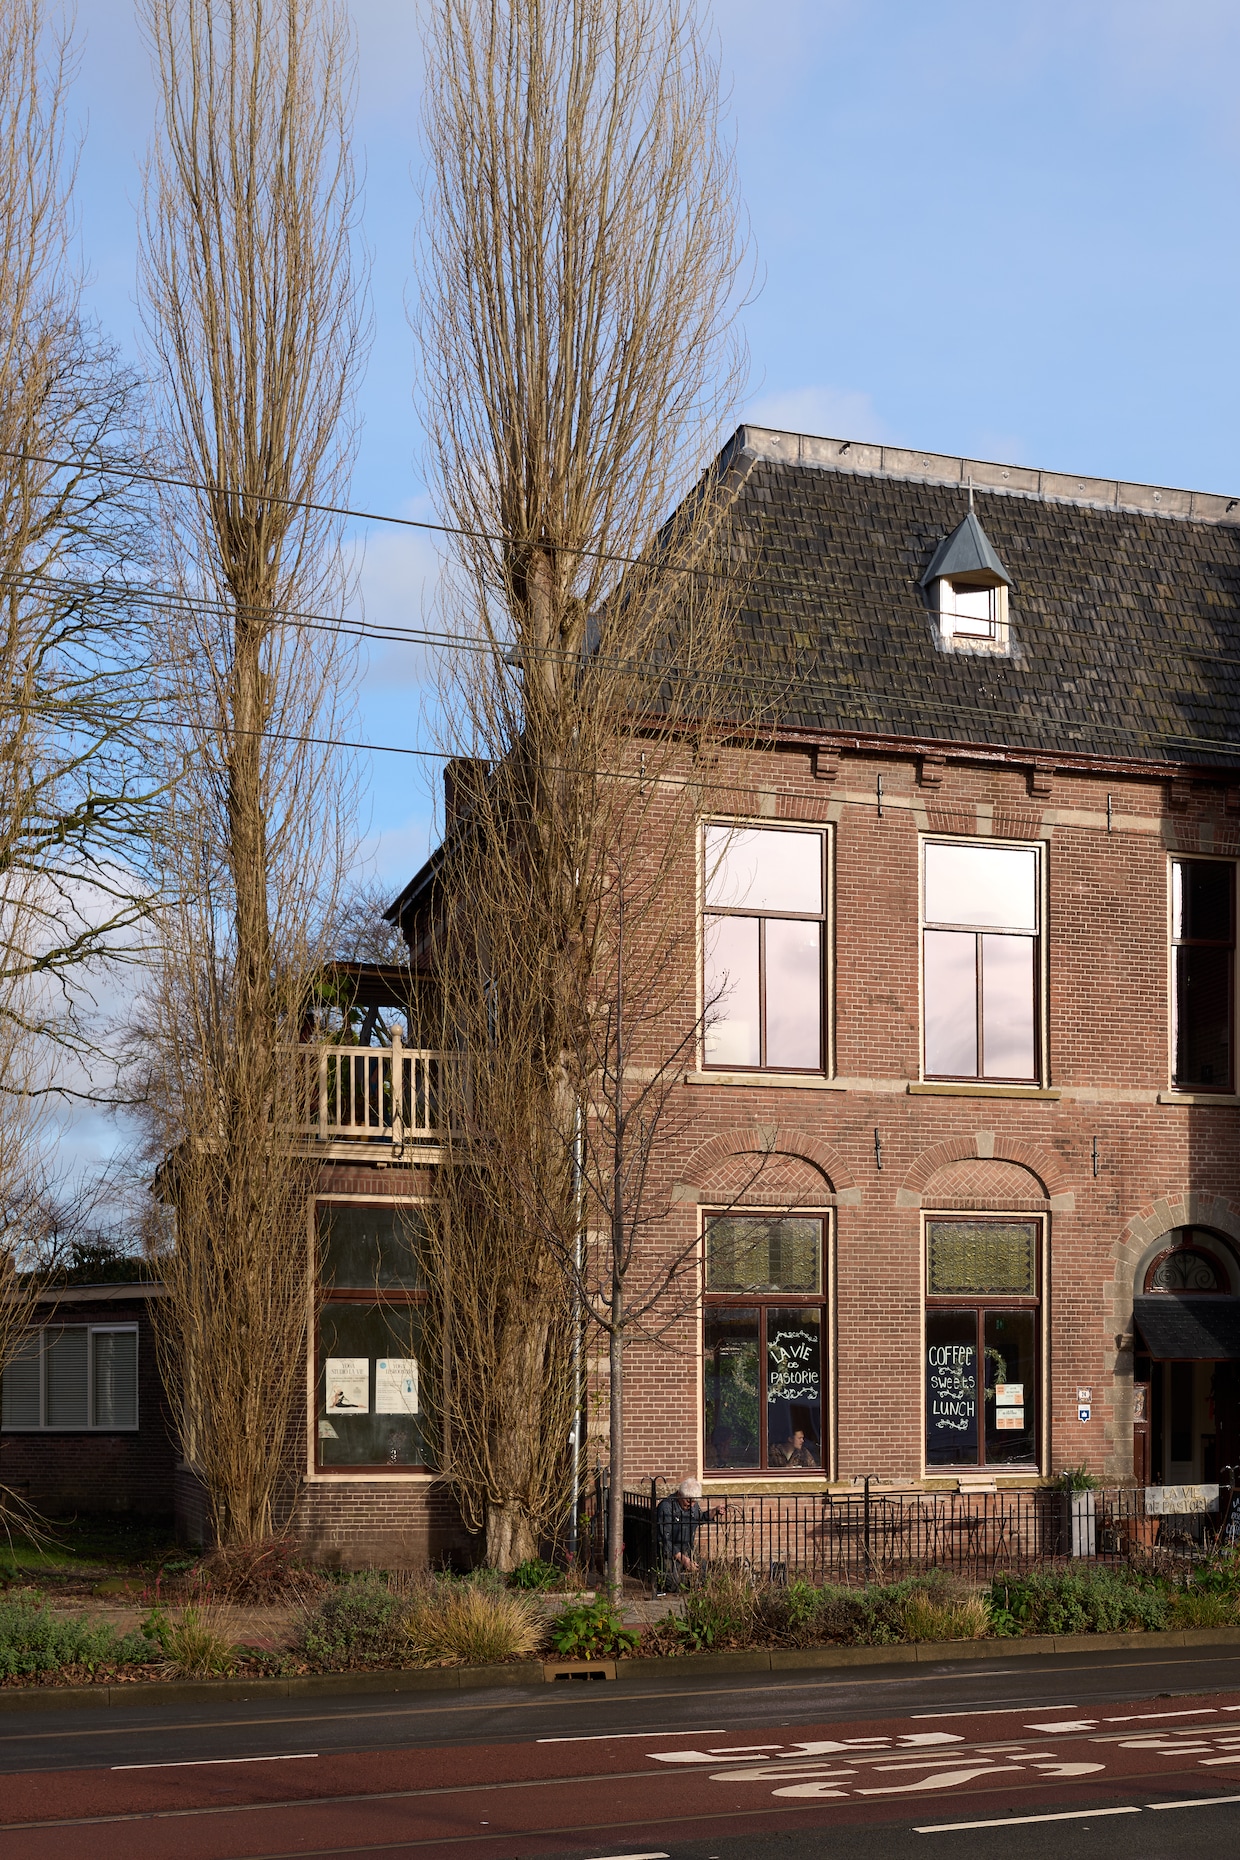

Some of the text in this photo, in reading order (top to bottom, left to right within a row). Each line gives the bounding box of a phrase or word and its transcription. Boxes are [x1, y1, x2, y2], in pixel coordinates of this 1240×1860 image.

[770, 1347, 791, 1364] LA
[933, 1400, 975, 1417] LUNCH
[1162, 1487, 1177, 1499] LA
